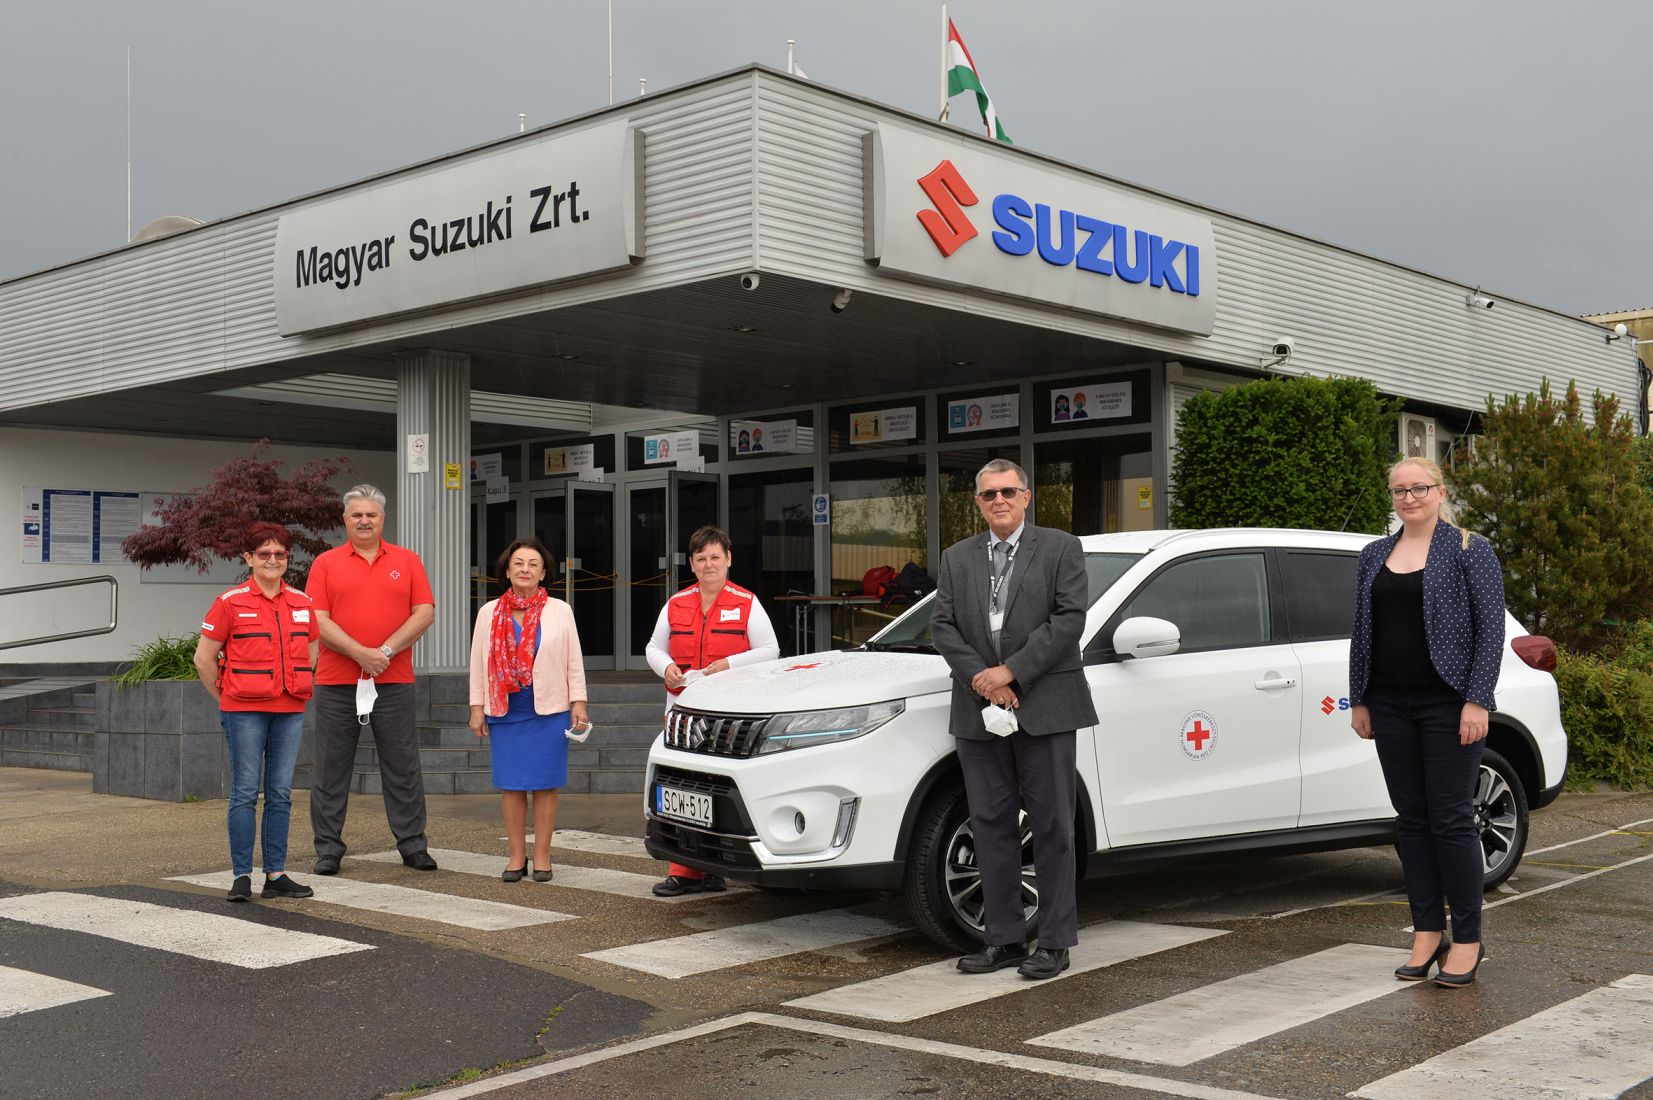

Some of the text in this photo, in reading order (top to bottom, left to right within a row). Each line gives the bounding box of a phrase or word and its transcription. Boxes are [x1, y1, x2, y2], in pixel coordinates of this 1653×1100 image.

[295, 181, 590, 290] Magyar Suzuki Zrt.
[991, 193, 1200, 297] SUZUKI
[502, 484, 507, 494] 3
[663, 790, 710, 820] SCW-512
